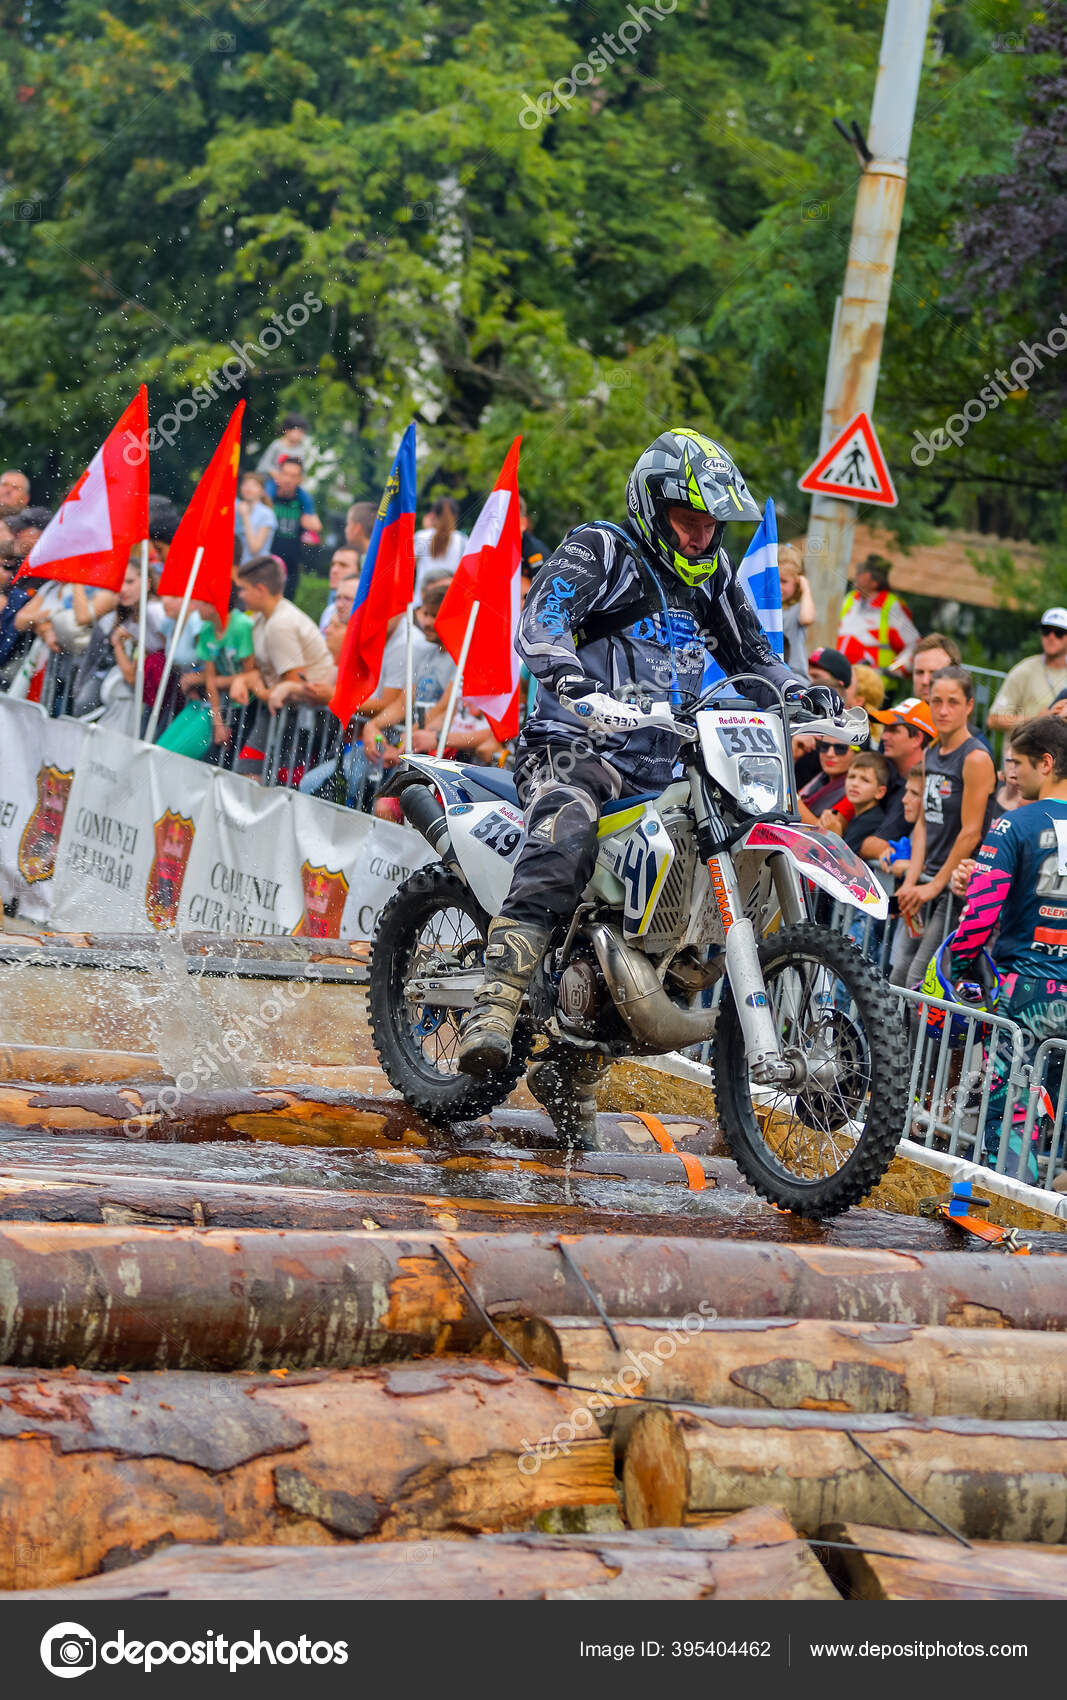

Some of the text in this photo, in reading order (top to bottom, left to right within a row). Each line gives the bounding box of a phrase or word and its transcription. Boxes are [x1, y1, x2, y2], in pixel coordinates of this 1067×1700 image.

[593, 713, 639, 728] CERBIS
[722, 727, 777, 754] 319
[474, 814, 521, 857] 319
